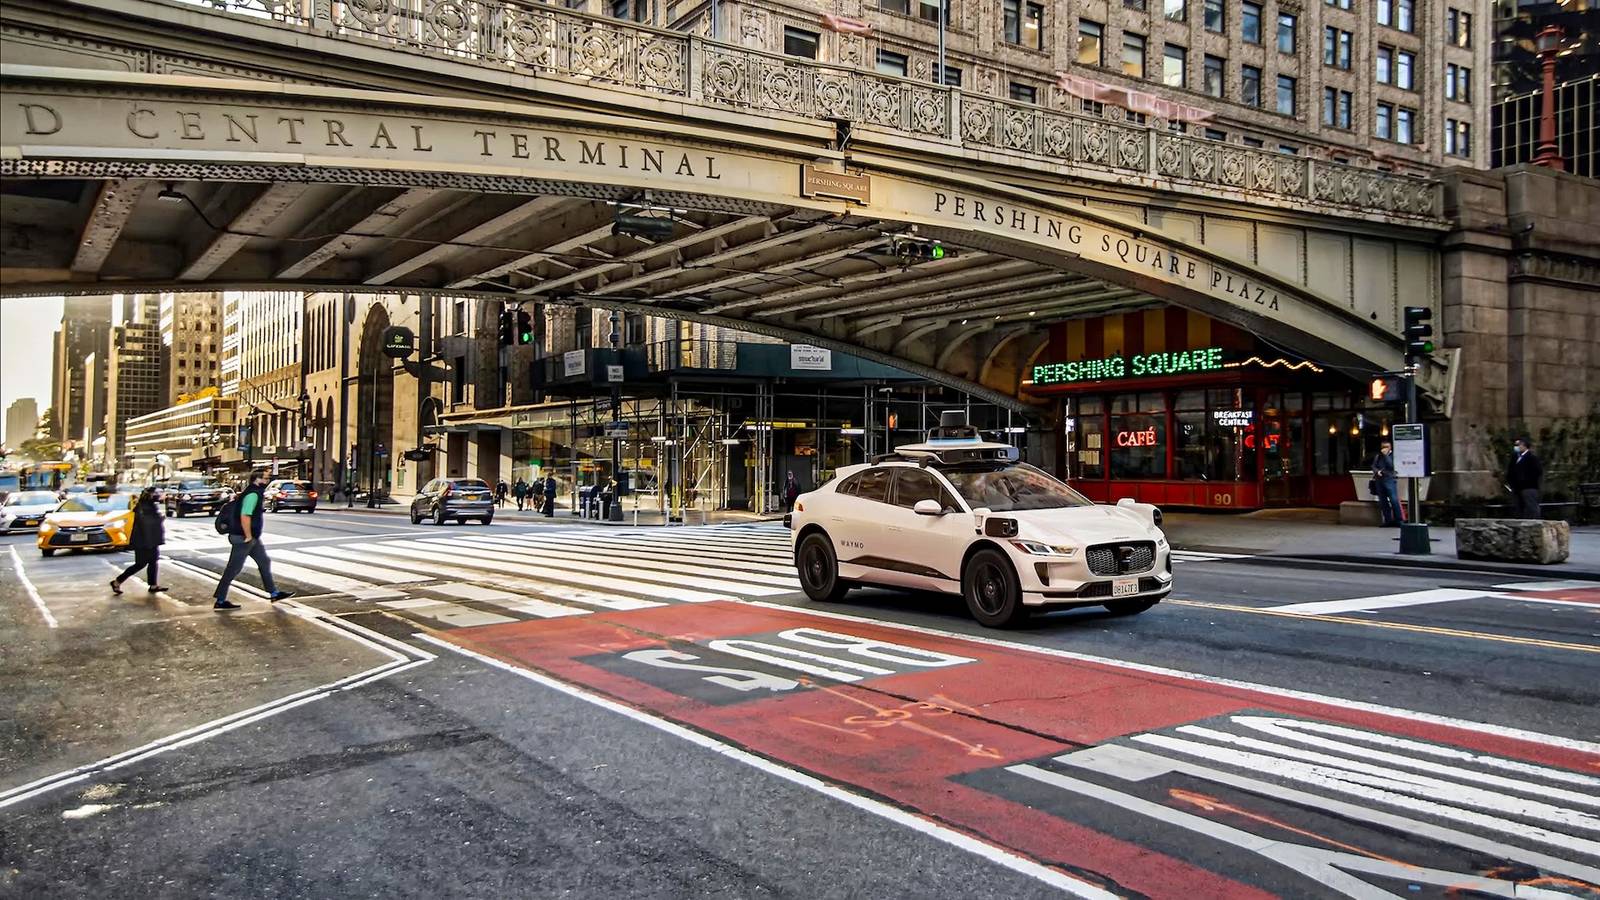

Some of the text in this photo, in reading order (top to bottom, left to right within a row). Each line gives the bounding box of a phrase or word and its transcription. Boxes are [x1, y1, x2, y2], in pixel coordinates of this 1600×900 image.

[18, 103, 721, 180] D CENTRAL TERMINAL
[807, 177, 867, 192] PERSHING SQUARE
[934, 192, 1280, 312] PERSHING SQUARE PLAZA
[1033, 348, 1223, 384] PERSHING SQUARE
[1213, 411, 1253, 419] BREAKFAST
[1117, 426, 1156, 446] CAFÉ
[1214, 493, 1232, 505] 90
[841, 540, 865, 549] WAYMO
[620, 627, 980, 691] BUS
